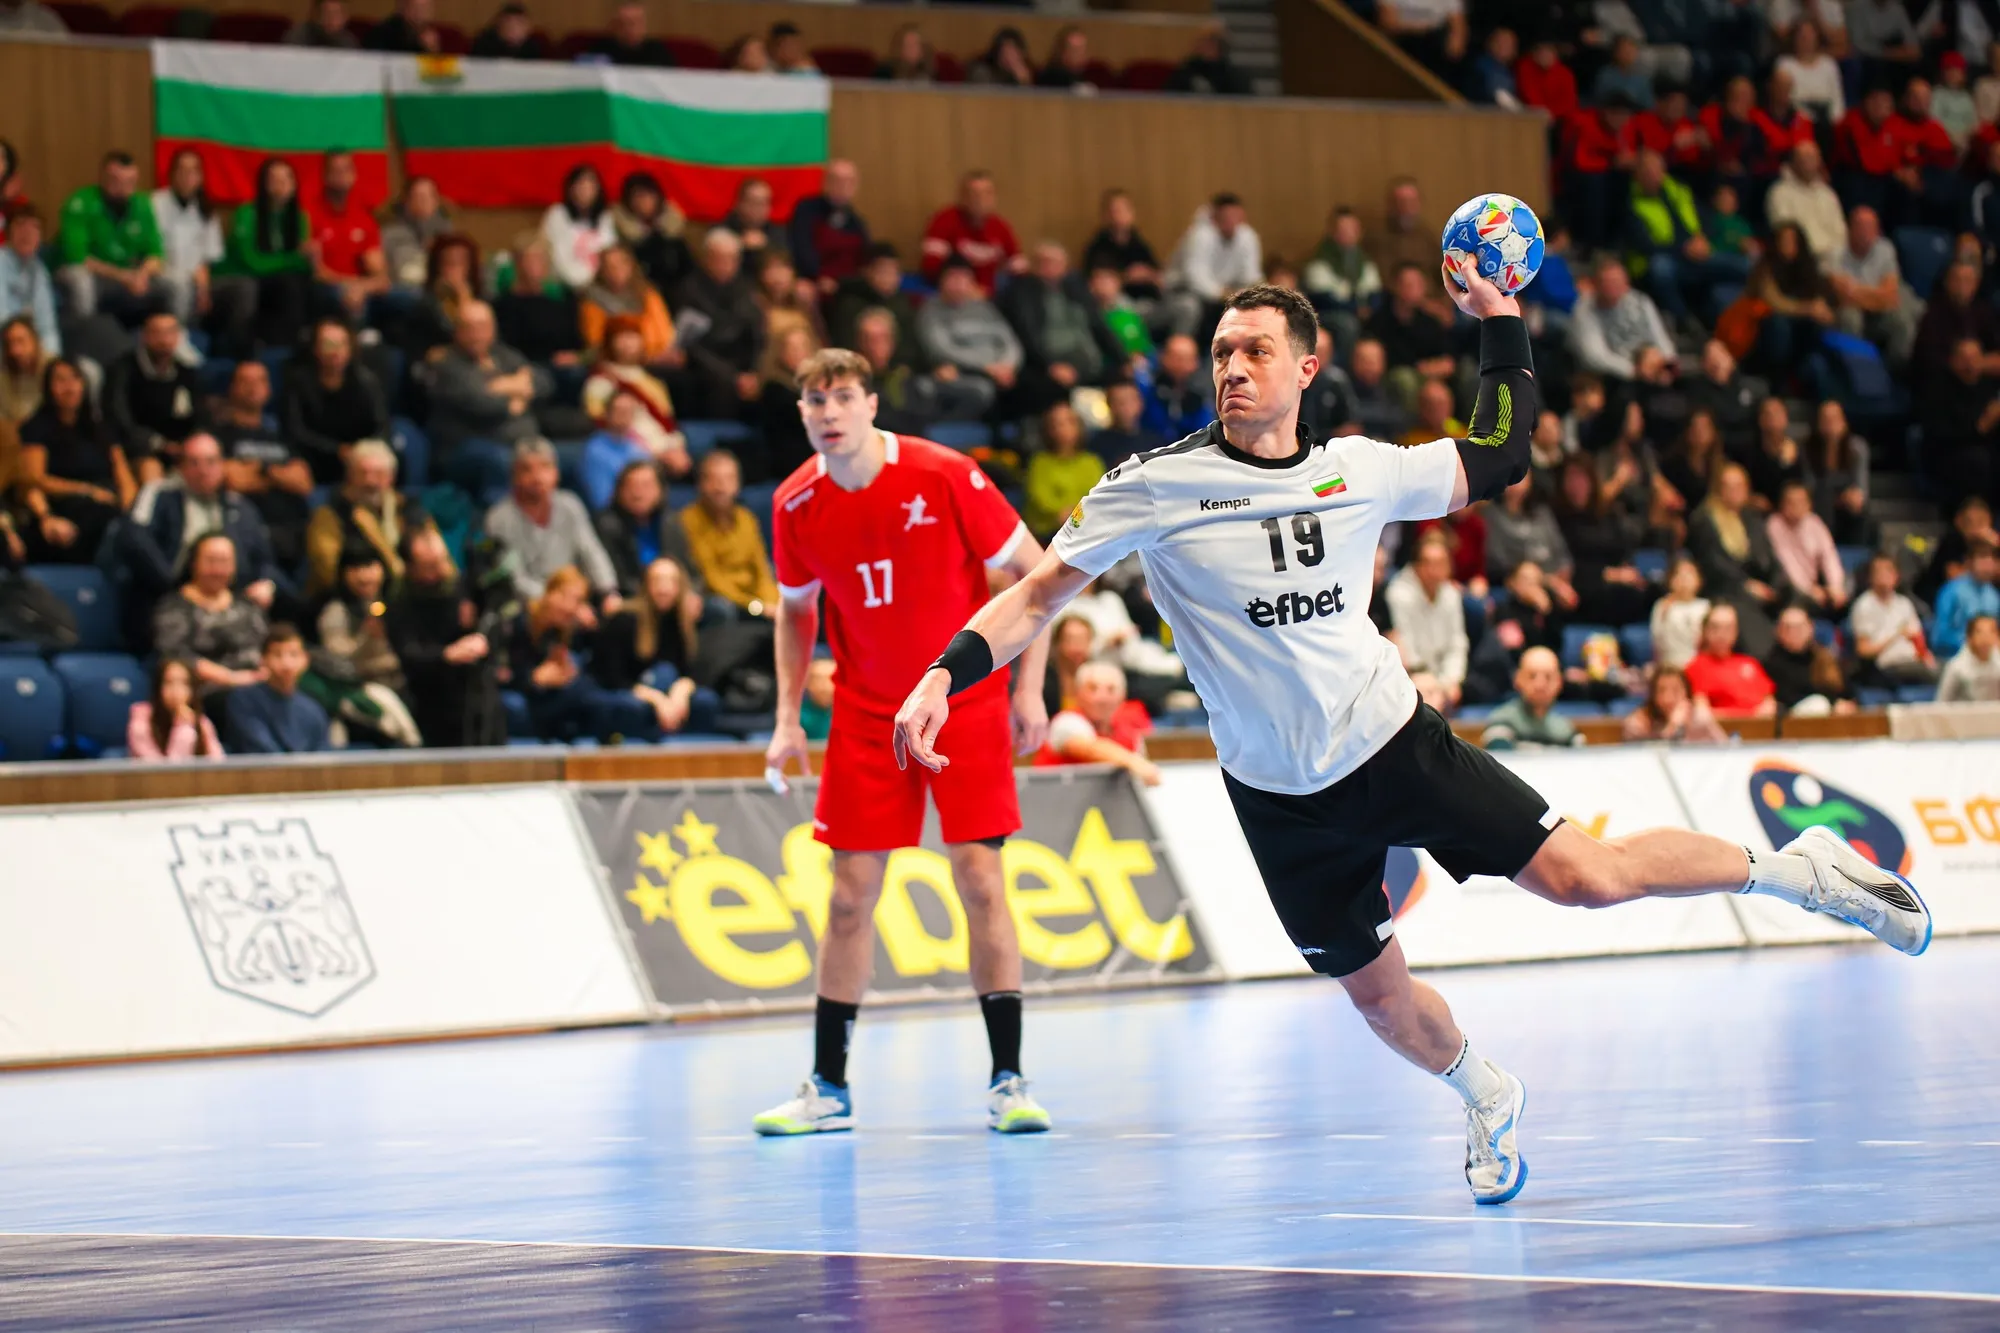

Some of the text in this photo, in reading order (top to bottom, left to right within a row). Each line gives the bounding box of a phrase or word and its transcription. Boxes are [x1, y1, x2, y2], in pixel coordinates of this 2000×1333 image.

[1200, 497, 1250, 511] Kempa
[1260, 511, 1325, 573] 19
[855, 558, 893, 608] 17
[1244, 582, 1345, 628] efbet
[199, 842, 301, 866] VARNA
